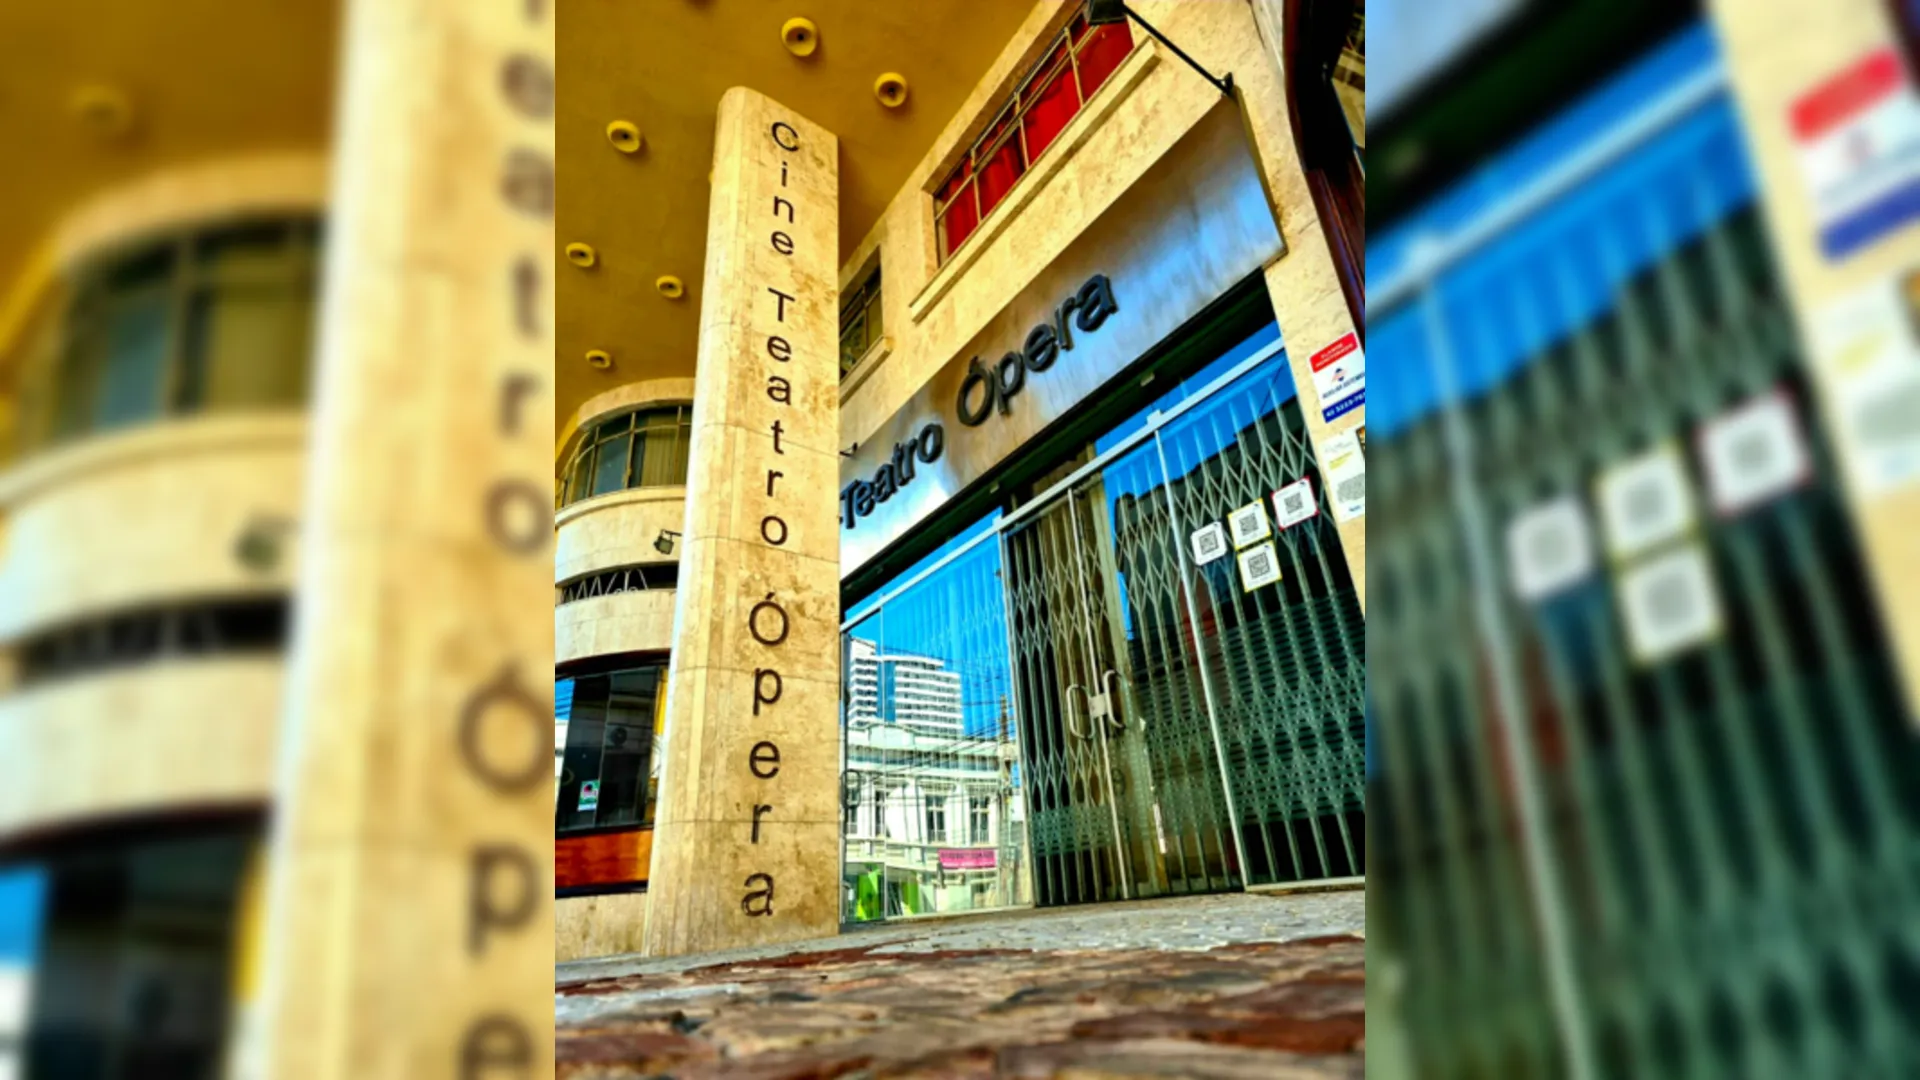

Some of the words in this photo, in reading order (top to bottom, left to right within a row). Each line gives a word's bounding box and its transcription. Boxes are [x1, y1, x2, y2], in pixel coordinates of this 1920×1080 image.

[770, 120, 800, 257] Cine
[760, 286, 796, 547] Teatro
[957, 274, 1119, 427] Ópera
[740, 591, 790, 917] Ópera
